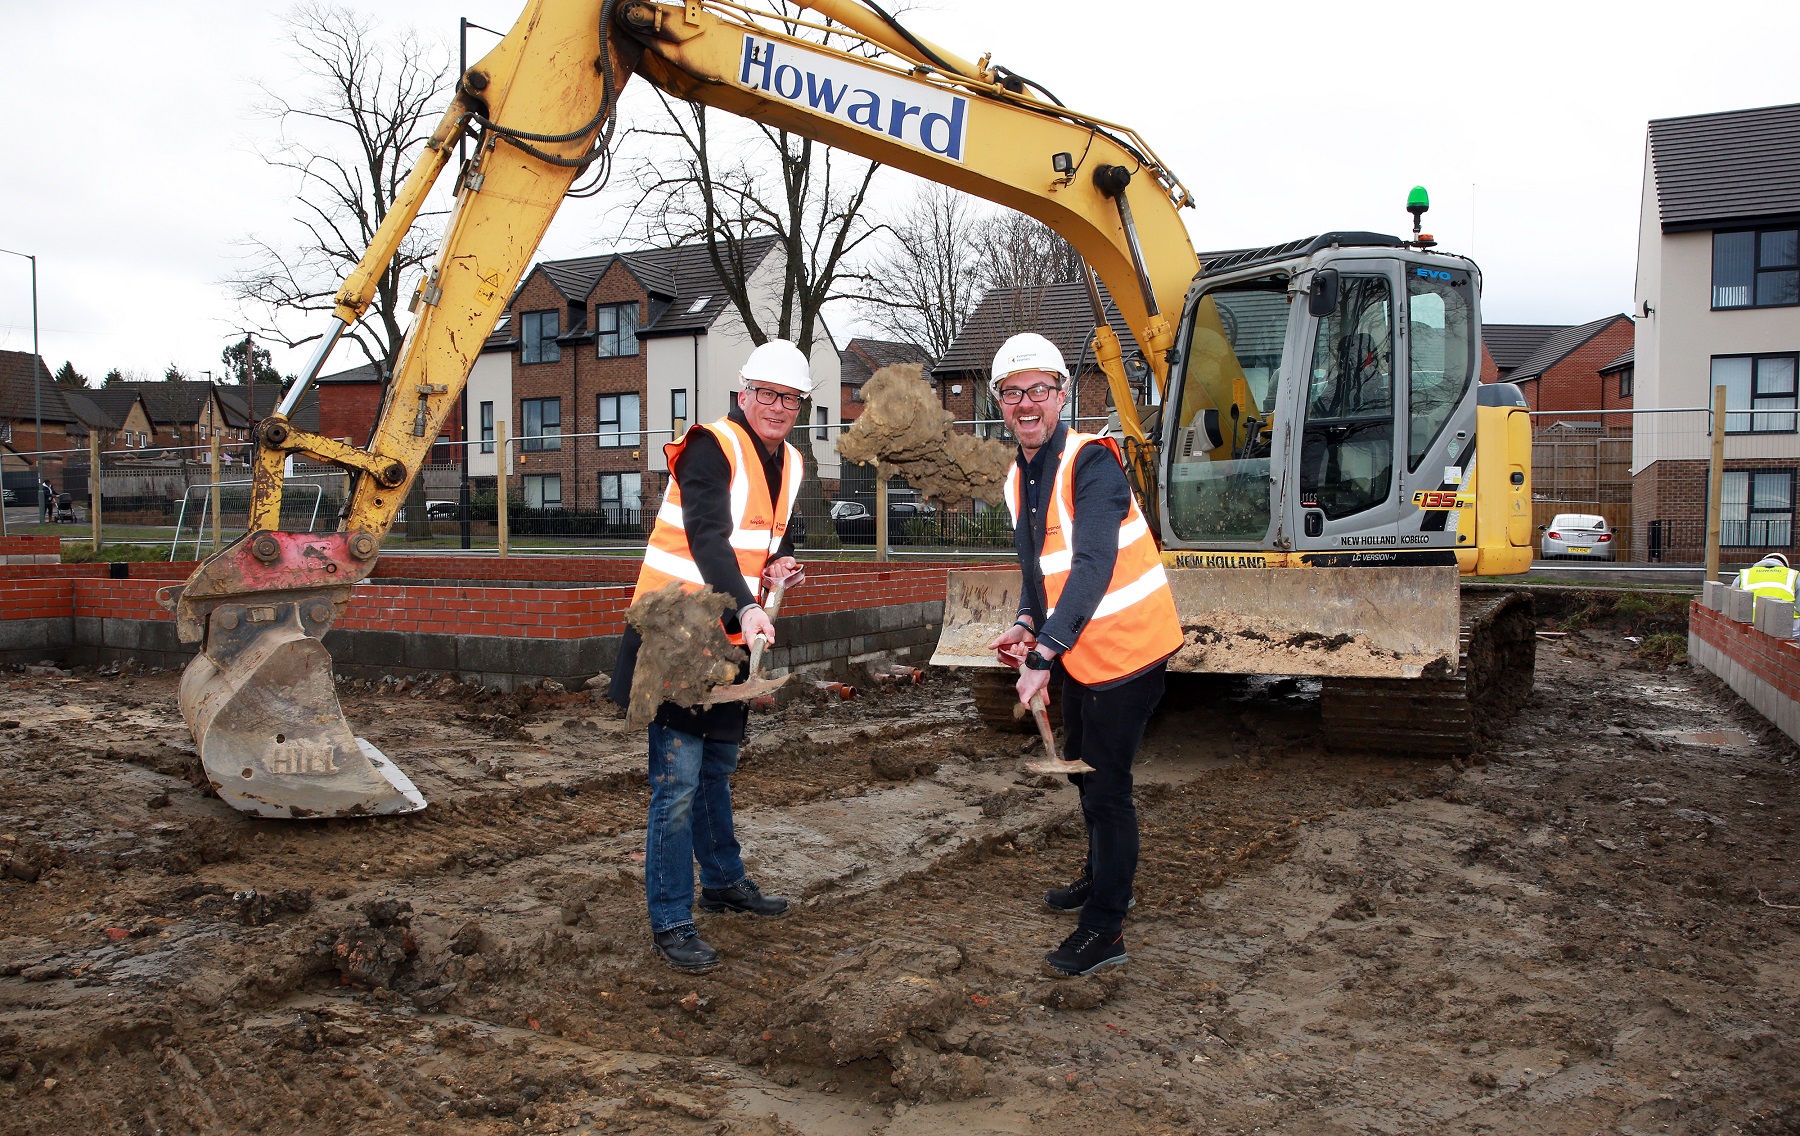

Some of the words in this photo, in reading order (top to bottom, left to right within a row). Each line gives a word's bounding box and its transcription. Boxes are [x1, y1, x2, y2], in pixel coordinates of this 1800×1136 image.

[741, 36, 966, 161] Howard
[1416, 267, 1451, 280] EVO
[1340, 536, 1360, 546] NEW
[1361, 535, 1397, 545] HOLLAND
[1400, 535, 1430, 544] KOBELCO
[1206, 556, 1267, 569] HOLLAND
[1351, 554, 1362, 562] LC
[273, 746, 338, 776] HILL
